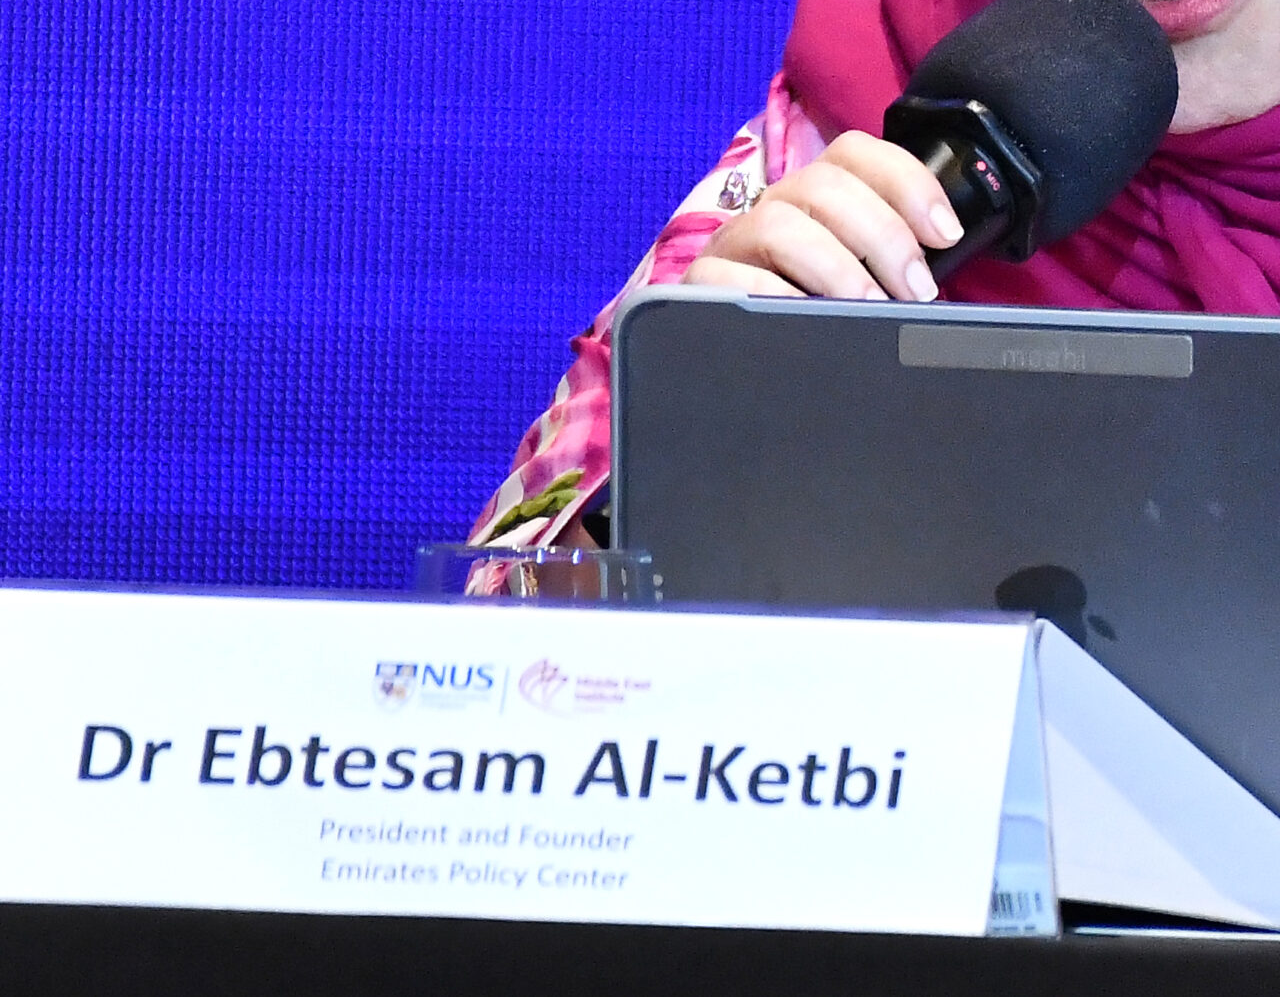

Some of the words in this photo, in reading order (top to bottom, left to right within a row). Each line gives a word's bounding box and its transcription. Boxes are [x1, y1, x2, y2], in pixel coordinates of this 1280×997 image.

[421, 662, 495, 692] NUS
[78, 724, 173, 784] Dr
[198, 724, 547, 795] Ebtesam
[573, 738, 906, 810] Al-Ketbi
[319, 817, 449, 846] President
[458, 823, 509, 848] and
[518, 824, 635, 852] Founder
[320, 856, 440, 884] Emirates
[449, 859, 530, 890] Policy
[537, 862, 630, 890] Center
